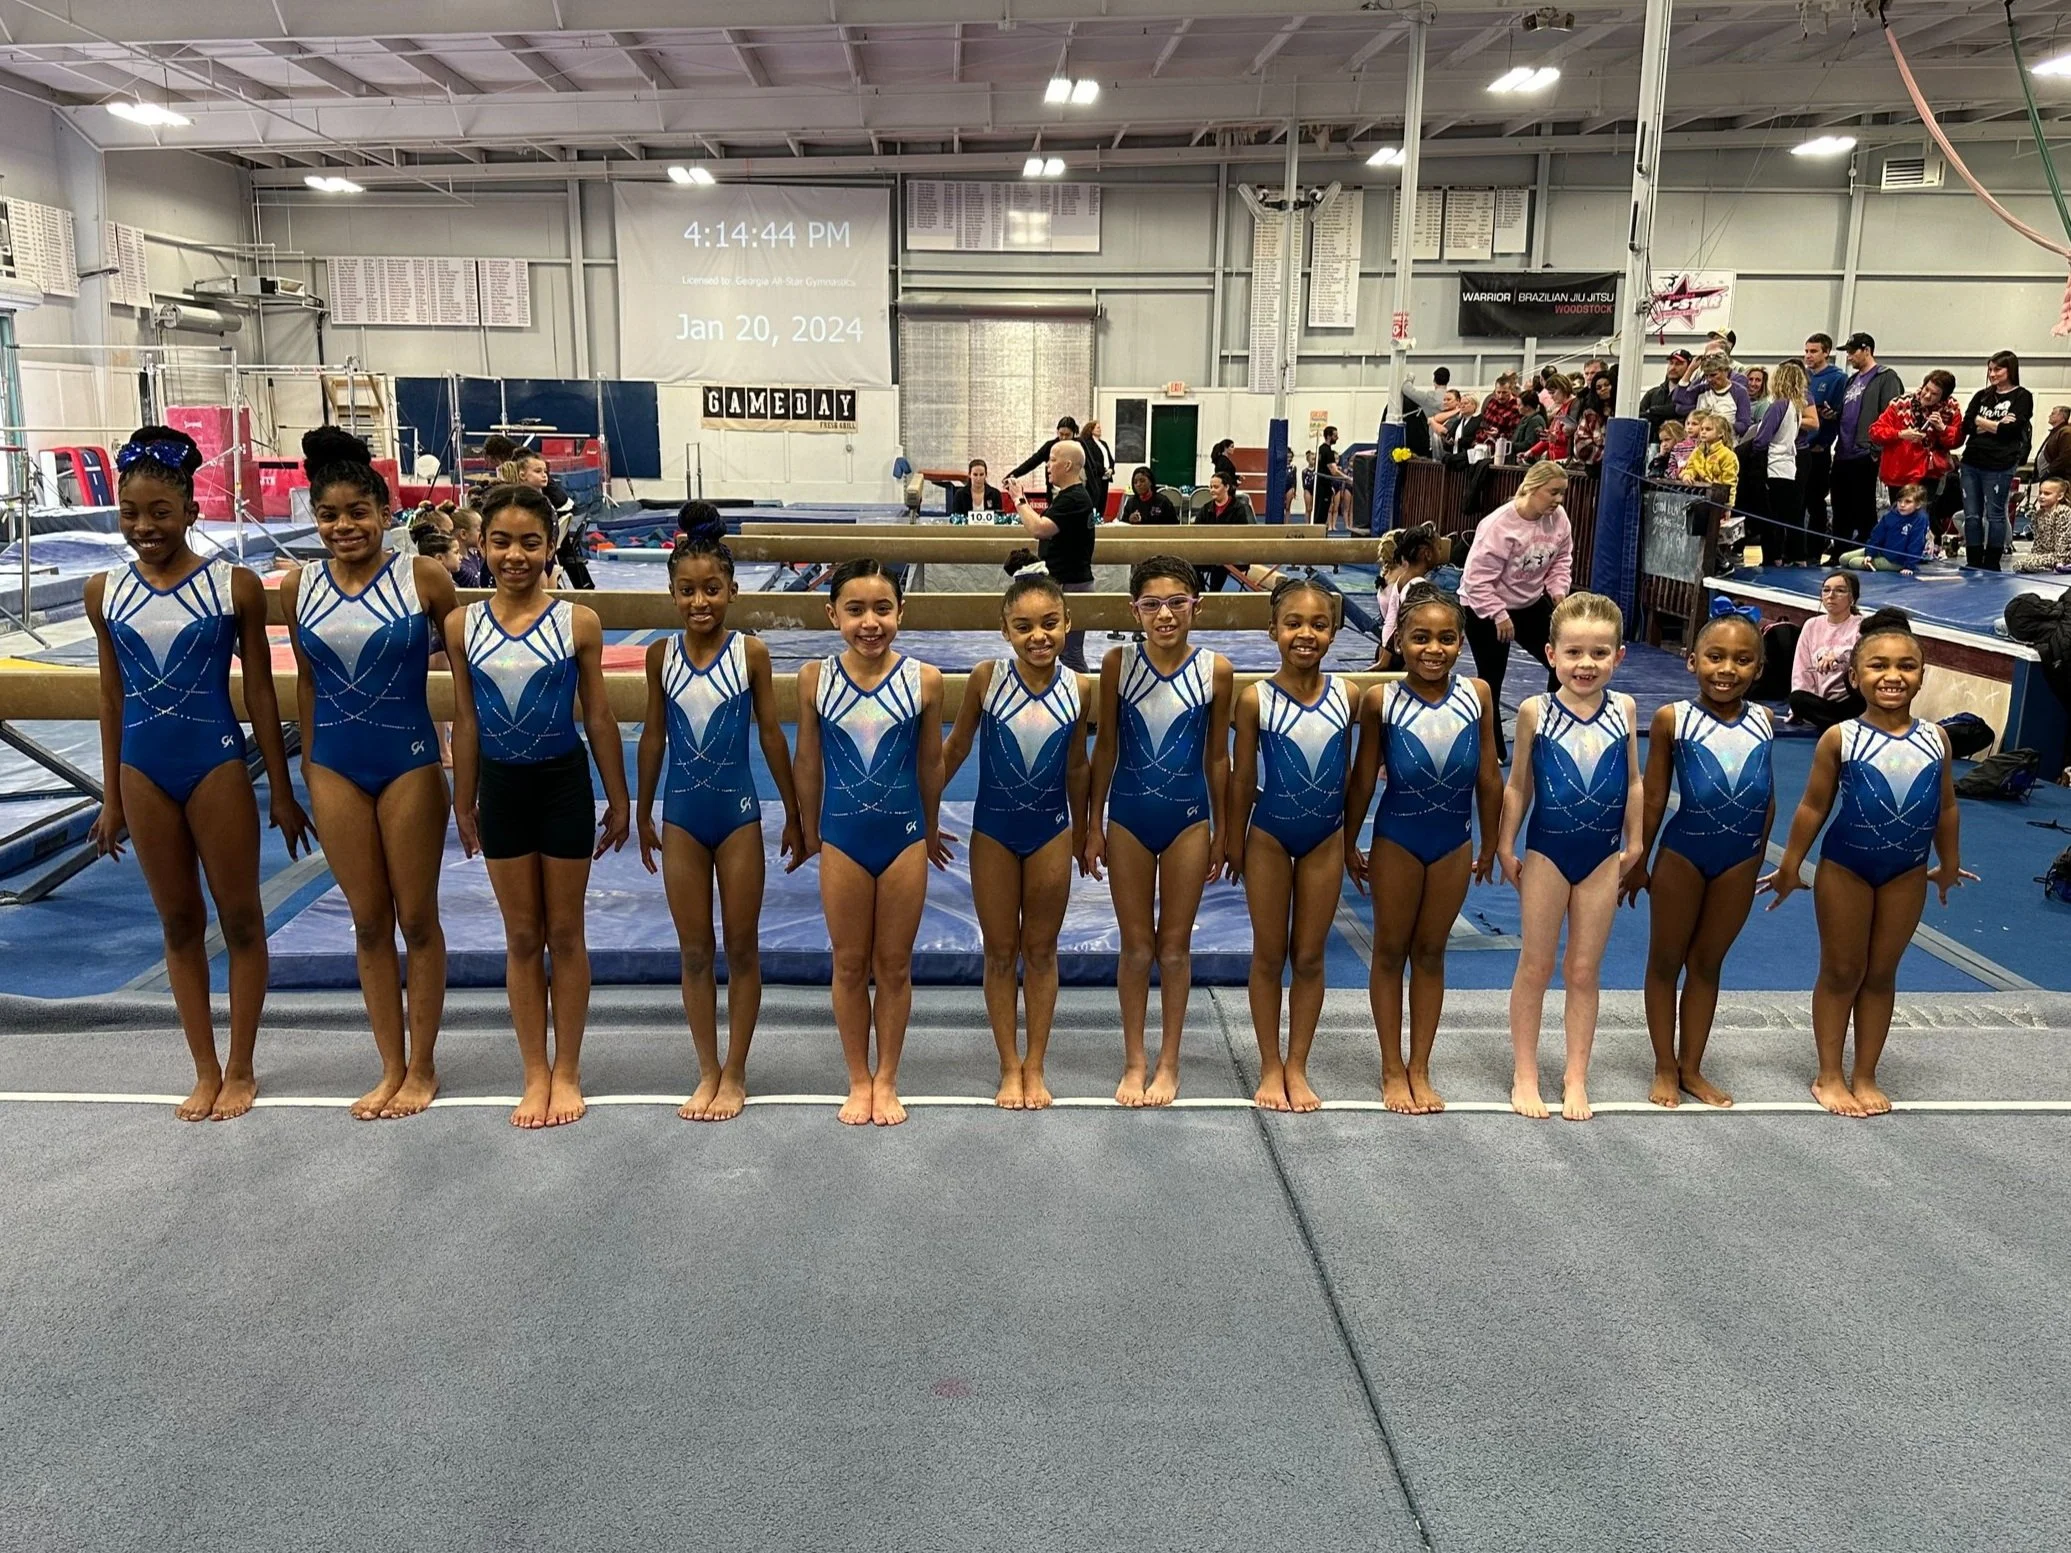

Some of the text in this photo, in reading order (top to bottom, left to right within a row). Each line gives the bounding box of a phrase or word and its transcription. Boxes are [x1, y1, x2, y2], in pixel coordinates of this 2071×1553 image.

[683, 220, 850, 249] 4:14:44 PM
[735, 276, 769, 288] Georgia
[1462, 292, 1614, 303] WARRIOR BRAZILIAN JIU JITSU
[1555, 304, 1613, 314] WOODSTOCK
[676, 314, 864, 348] Jan 20, 2024
[708, 391, 851, 416] GAMEDAY
[970, 512, 993, 521] 10.0
